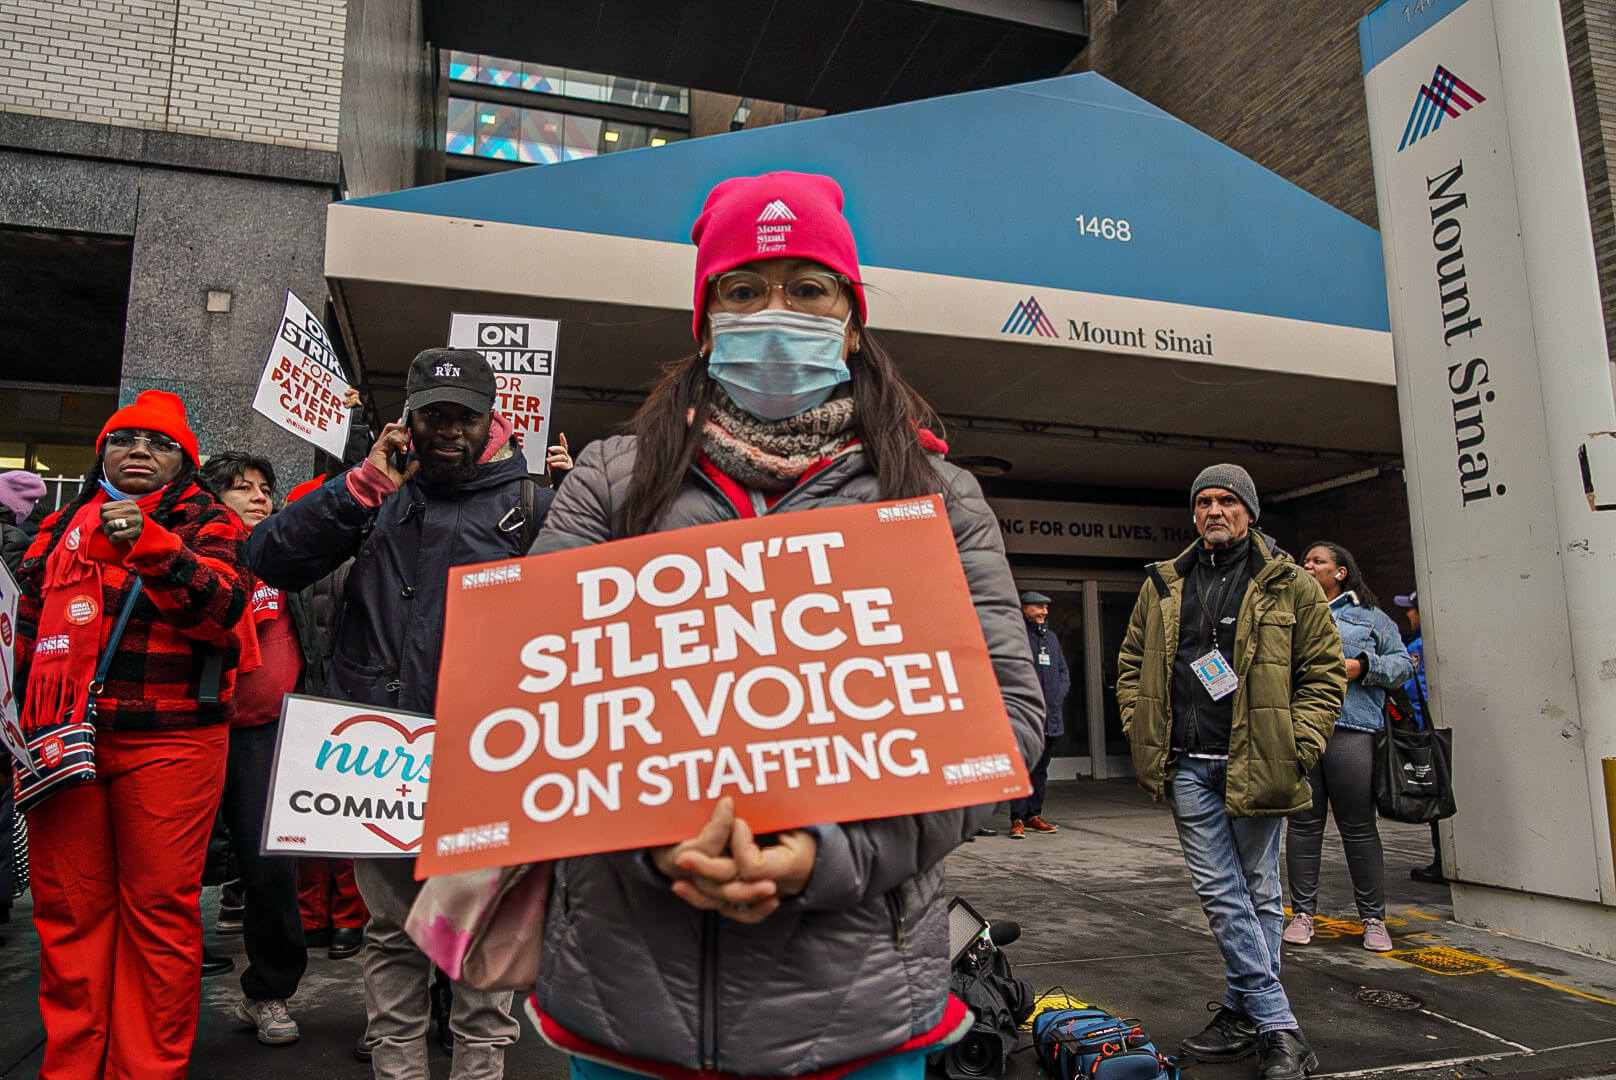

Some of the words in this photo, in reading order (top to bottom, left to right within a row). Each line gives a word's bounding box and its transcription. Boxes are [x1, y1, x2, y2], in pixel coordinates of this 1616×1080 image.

[757, 224, 792, 233] Mount
[757, 232, 785, 242] Sinai
[1076, 214, 1132, 242] 1468
[1425, 159, 1483, 347] Mount
[284, 322, 348, 382] STRIK
[481, 325, 523, 346] ON
[1067, 319, 1147, 348] Mount
[1155, 328, 1214, 355] Sinai
[280, 356, 344, 411] BETTER
[302, 357, 332, 388] FOR
[496, 376, 522, 392] OR
[271, 367, 345, 425] PATIENT
[280, 394, 328, 432] CARE
[1447, 357, 1507, 507] Sinai
[1029, 520, 1063, 536] FOR
[1068, 522, 1104, 538] OUR
[1109, 524, 1157, 543] LIVES,
[576, 532, 845, 621] DON'T
[518, 587, 903, 693] SILENCE
[469, 686, 662, 772] OUR
[671, 650, 964, 737] VOICE!
[315, 740, 433, 783] nurs
[522, 762, 623, 823] ON
[637, 728, 930, 807] STAFFING
[289, 790, 426, 820] COMMU
